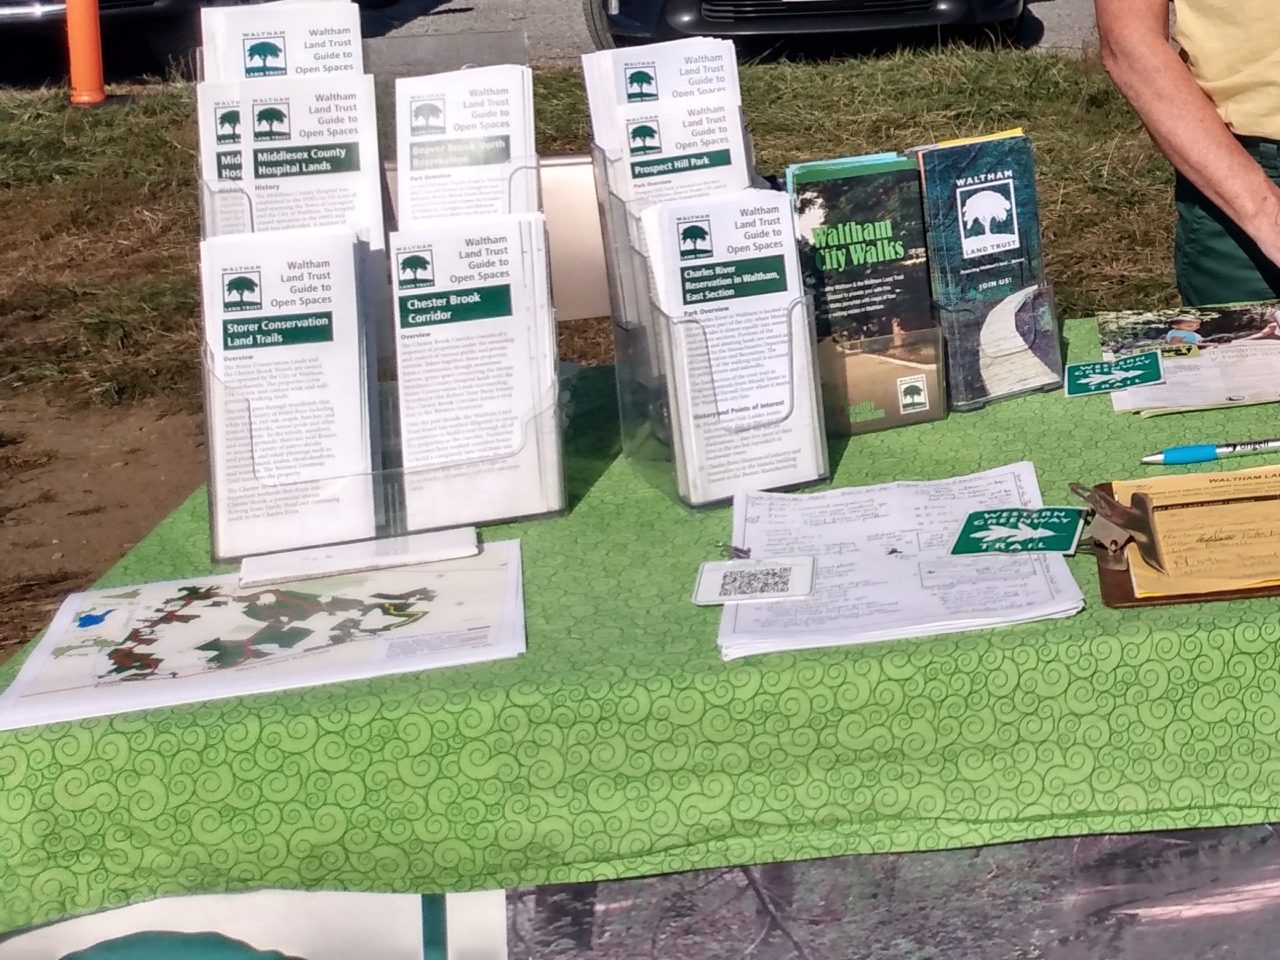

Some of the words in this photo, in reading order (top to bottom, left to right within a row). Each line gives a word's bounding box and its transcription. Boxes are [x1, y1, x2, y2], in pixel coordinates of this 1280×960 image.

[309, 28, 350, 37] Waltham
[304, 40, 325, 49] Land
[328, 39, 352, 48] Trust
[314, 51, 340, 60] Guide
[684, 55, 723, 64] Waltham
[295, 66, 320, 75] Open
[323, 64, 354, 72] Spaces
[680, 66, 700, 75] Land
[704, 64, 724, 73] Trust
[688, 77, 713, 86] Guide
[315, 93, 357, 102] Waltham
[469, 88, 509, 97] Waltham
[672, 90, 695, 98] Open
[697, 87, 726, 95] Spaces
[309, 106, 330, 114] Land
[500, 110, 510, 118] to
[687, 106, 725, 116] Waltham
[318, 116, 344, 125] Guide
[682, 118, 703, 127] Land
[706, 116, 726, 125] Trust
[300, 130, 325, 138] Open
[327, 127, 359, 137] Spaces
[454, 123, 477, 132] Open
[480, 122, 510, 130] Spaces
[691, 128, 716, 137] Guide
[675, 141, 698, 150] Open
[700, 138, 729, 147] Spaces
[258, 152, 308, 162] Middlesex
[311, 148, 346, 159] County
[258, 165, 300, 176] Hospital
[302, 162, 331, 172] Lands
[635, 161, 672, 174] Prospect
[674, 159, 689, 168] Hill
[691, 156, 709, 165] Park
[648, 179, 672, 187] Overview
[956, 170, 1013, 186] WALTHAM
[740, 206, 779, 217] Waltham
[735, 220, 756, 229] Land
[759, 218, 781, 226] Trust
[744, 231, 770, 240] Guide
[811, 219, 893, 248] Waltham
[465, 235, 507, 246] Waltham
[459, 250, 483, 259] Land
[486, 247, 508, 256] Trust
[727, 245, 750, 255] Open
[753, 242, 783, 251] Spaces
[966, 246, 988, 256] LAND
[991, 240, 1016, 250] TRUST
[815, 247, 846, 272] City
[849, 240, 905, 265] Walks
[288, 260, 330, 269] Waltham
[468, 260, 496, 269] Guide
[281, 273, 303, 282] Land
[307, 272, 331, 280] Trust
[450, 275, 475, 284] Open
[478, 270, 510, 281] Spaces
[684, 267, 714, 279] Charles
[715, 265, 736, 275] River
[685, 277, 733, 290] Reservation
[734, 275, 741, 283] in
[742, 271, 780, 283] Waltham,
[980, 281, 996, 290] JOIN
[290, 284, 318, 294] Guide
[407, 297, 447, 310] Chester
[450, 292, 481, 305] Brook
[686, 293, 703, 302] East
[705, 289, 734, 299] Section
[271, 299, 296, 308] Open
[299, 296, 332, 306] Spaces
[699, 306, 729, 314] Overview
[408, 311, 452, 323] Corridor
[227, 322, 258, 333] Storer
[261, 317, 328, 330] Conservation
[228, 336, 253, 346] Land
[256, 333, 283, 344] Trails
[401, 332, 431, 340] Overview
[1089, 379, 1141, 390] TRAIL
[694, 411, 718, 420] History
[731, 406, 750, 414] Points
[760, 400, 785, 409] Interest
[1240, 440, 1269, 451] angell
[1209, 474, 1262, 483] WALTHAM
[983, 511, 1065, 519] WESTERN
[974, 517, 1071, 526] GREENWAY
[979, 542, 1046, 550] TRAIL
